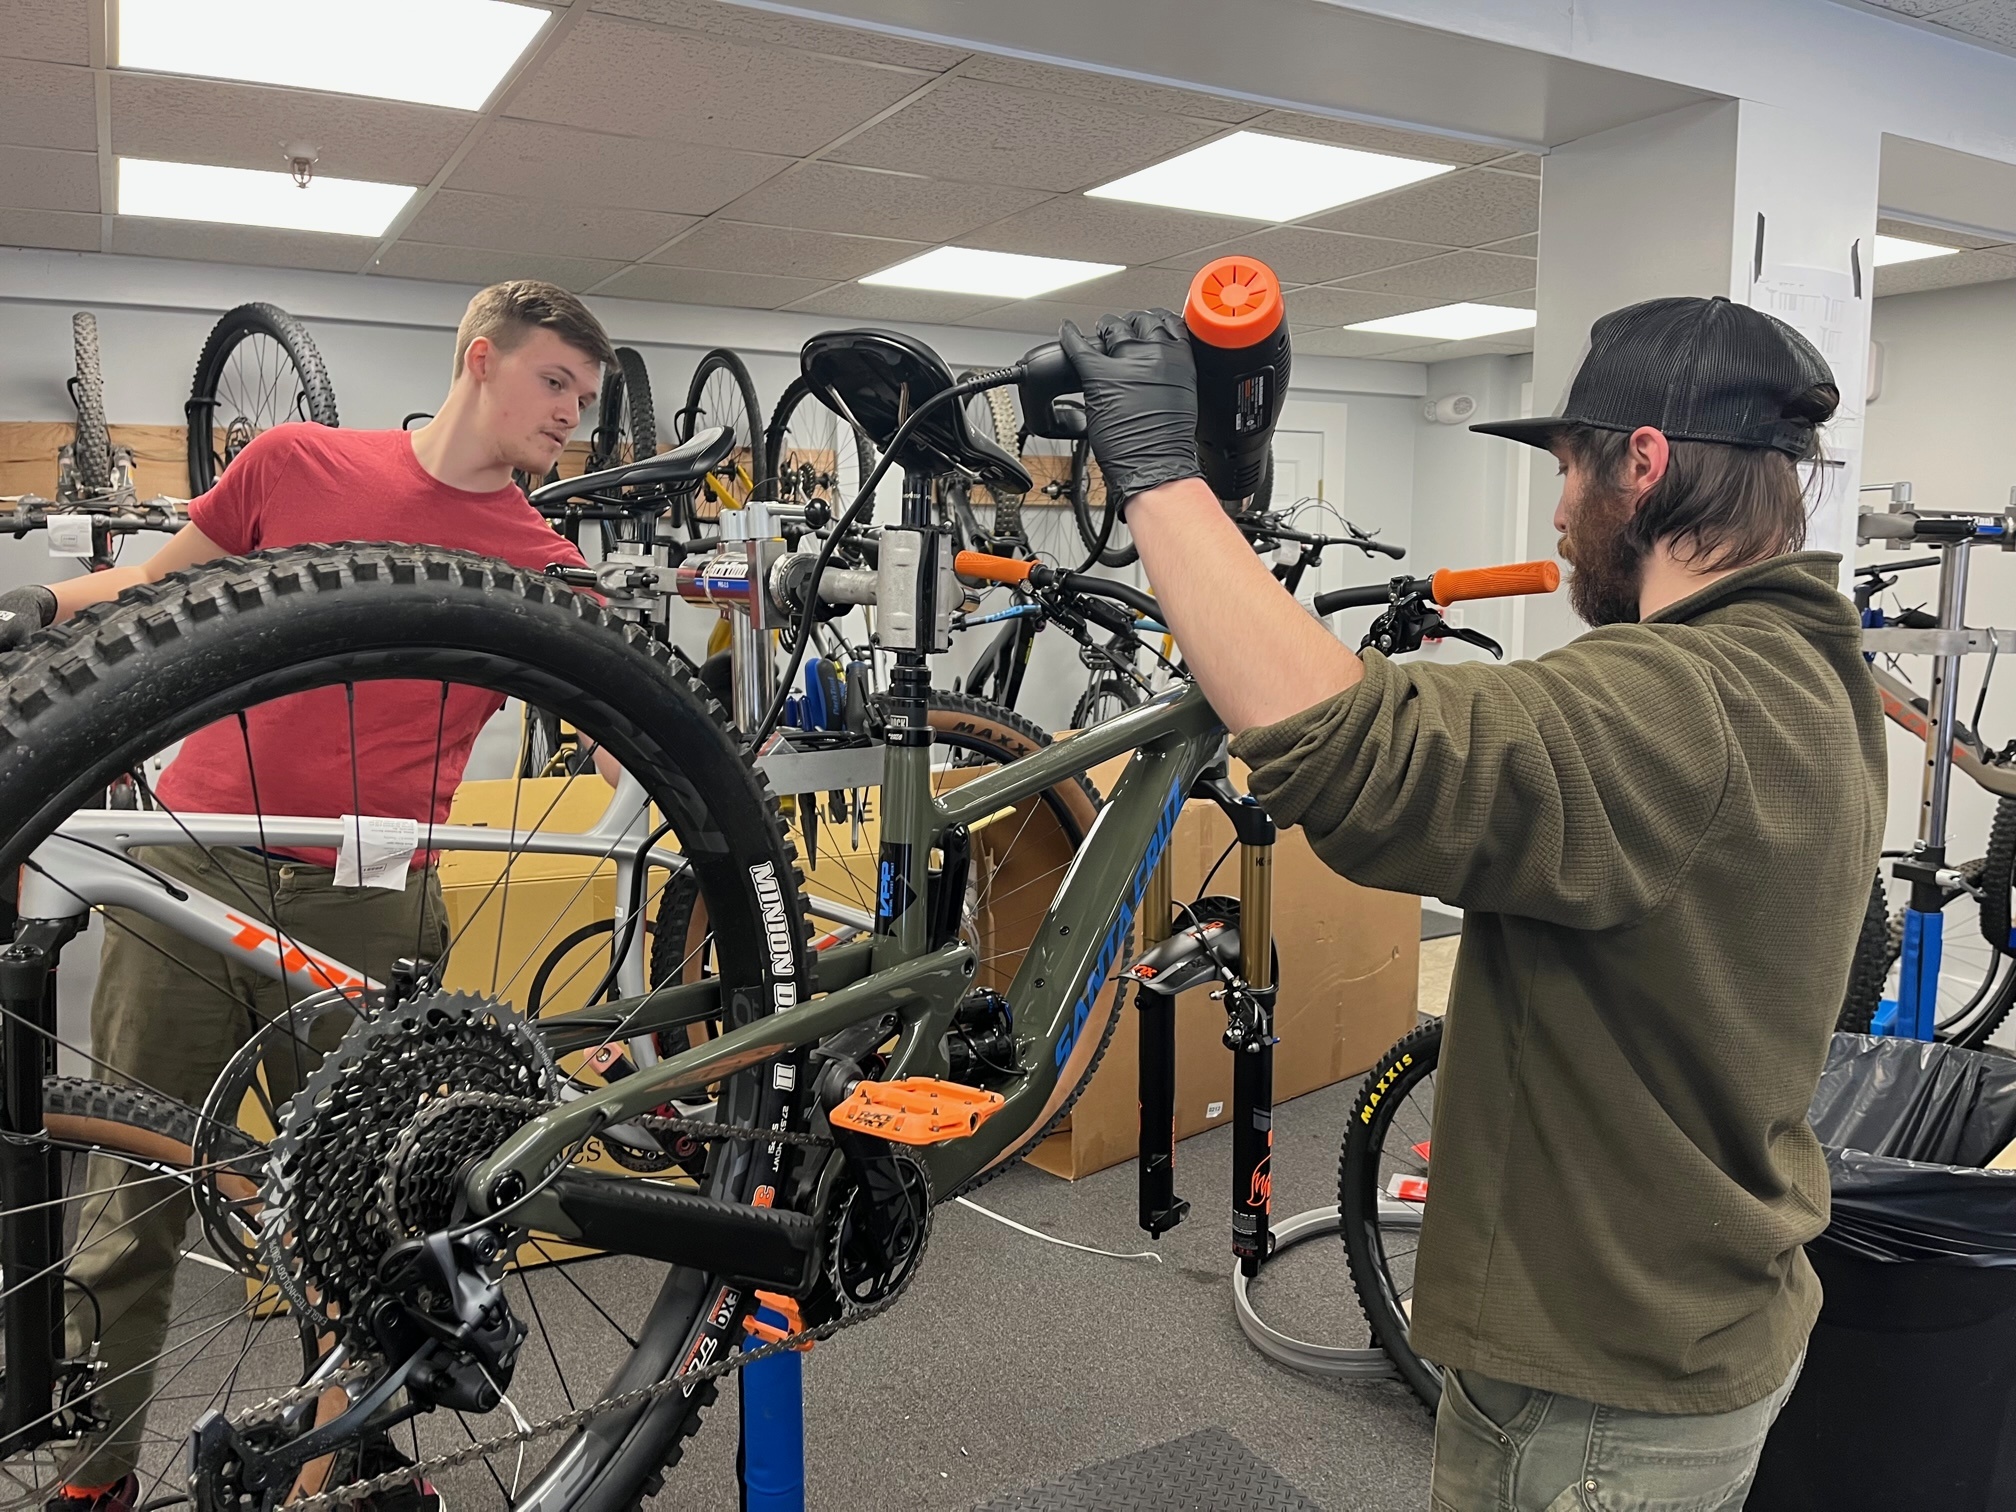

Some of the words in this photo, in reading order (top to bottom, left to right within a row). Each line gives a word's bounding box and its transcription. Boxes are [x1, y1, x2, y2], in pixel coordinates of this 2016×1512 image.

[748, 860, 795, 976] MINION
[1360, 1053, 1413, 1125] MAXXIS
[275, 1263, 308, 1311] TECHNOLOGY
[304, 1305, 329, 1327] EAGLE
